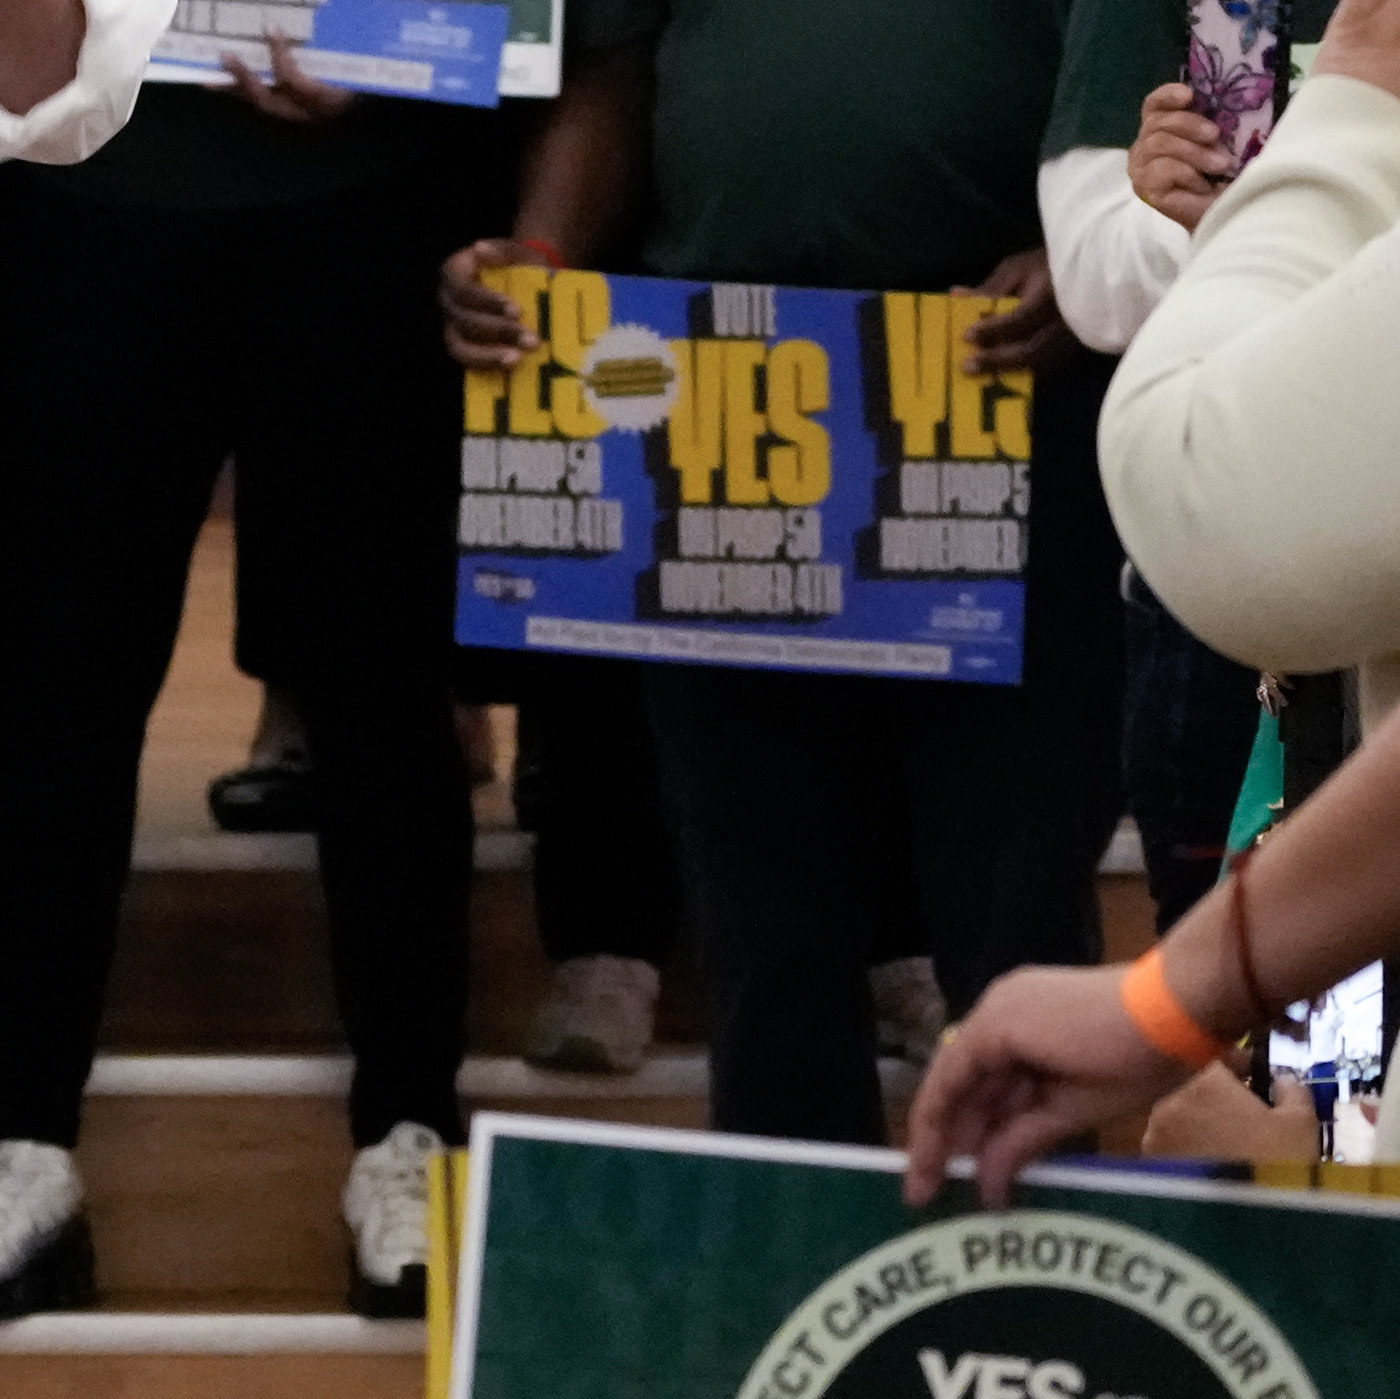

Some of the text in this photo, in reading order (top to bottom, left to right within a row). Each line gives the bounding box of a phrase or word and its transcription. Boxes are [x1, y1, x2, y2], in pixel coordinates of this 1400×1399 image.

[666, 339, 832, 506] YES
[821, 1249, 956, 1342] CARE,
[961, 1230, 1186, 1305] PROTECT
[1182, 1293, 1271, 1385] OUR
